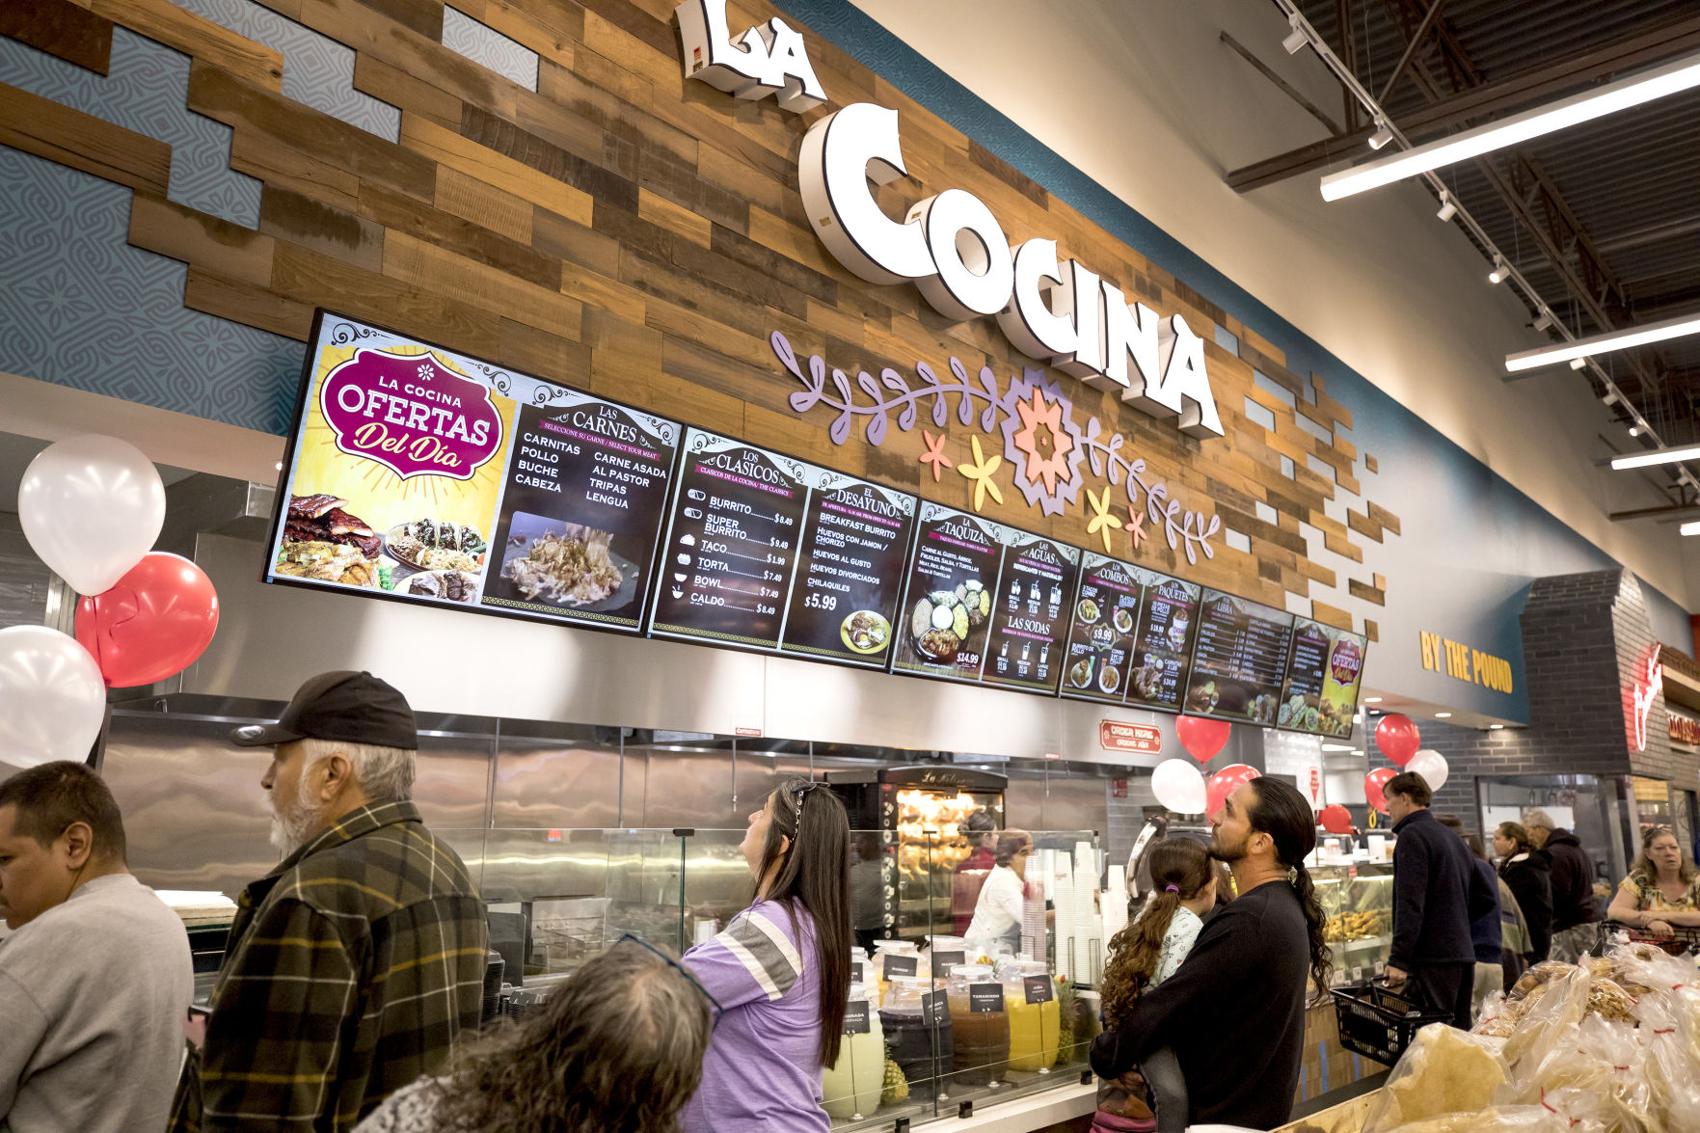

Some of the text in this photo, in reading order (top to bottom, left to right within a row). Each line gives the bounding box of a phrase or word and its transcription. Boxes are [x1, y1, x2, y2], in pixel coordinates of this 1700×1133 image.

[692, 0, 829, 106] LA
[804, 102, 1225, 438] COCINA
[378, 375, 462, 408] LA COCINA
[337, 384, 491, 447] OFERTAS
[599, 405, 618, 420] LAS
[573, 411, 638, 443] CARNES
[353, 422, 462, 468] Del Día
[523, 432, 581, 455] CARNITAS
[578, 432, 587, 440] SU
[586, 435, 604, 446] CARNE
[608, 440, 627, 451] SELECT
[628, 446, 642, 456] YOUR
[642, 449, 657, 460] MEAT
[520, 446, 559, 464] POLLO
[743, 450, 759, 463] LOS
[518, 460, 559, 478] BUCHE
[594, 451, 667, 479] CARNE ASADA
[716, 453, 780, 484] CLASICOS
[515, 474, 562, 493] CABEZA
[592, 465, 650, 488] AL PASTOR
[589, 478, 627, 495] TRIPAS
[863, 487, 873, 499] EL
[586, 491, 629, 509] LENGUA
[709, 496, 752, 515] BURRITO
[836, 489, 897, 517] DESAYUNO
[706, 514, 740, 529] SUPER
[820, 512, 865, 531] BREAKFAST
[864, 525, 896, 540] BURRITO
[962, 517, 971, 528] LA
[704, 522, 747, 540] BURRITO
[817, 527, 845, 541] HUEVOS
[845, 535, 860, 545] CON
[860, 539, 882, 550] JAMON
[944, 521, 984, 544] TAQUIZA
[701, 539, 728, 554] TACO
[815, 535, 846, 548] CHORIZO
[1038, 541, 1049, 551] LAS
[698, 557, 729, 572] TORTA
[813, 548, 872, 569] HUEVOS AL GUSTO
[1028, 547, 1056, 565] AGUAS
[694, 575, 722, 588] BOWL
[810, 562, 880, 585] HUEVOS DIVORCIADOS
[1100, 567, 1130, 585] COMBOS
[807, 577, 851, 593] CHILAQUILES
[1159, 584, 1189, 601] PAQUETES
[690, 593, 725, 606] CALDO
[804, 592, 837, 611] $5.99
[1007, 615, 1024, 630] LAS
[1024, 619, 1051, 635] SODAS
[1093, 628, 1112, 641] $9.99
[956, 652, 979, 665] $14.99
[1420, 630, 1513, 696] BY THE POUND
